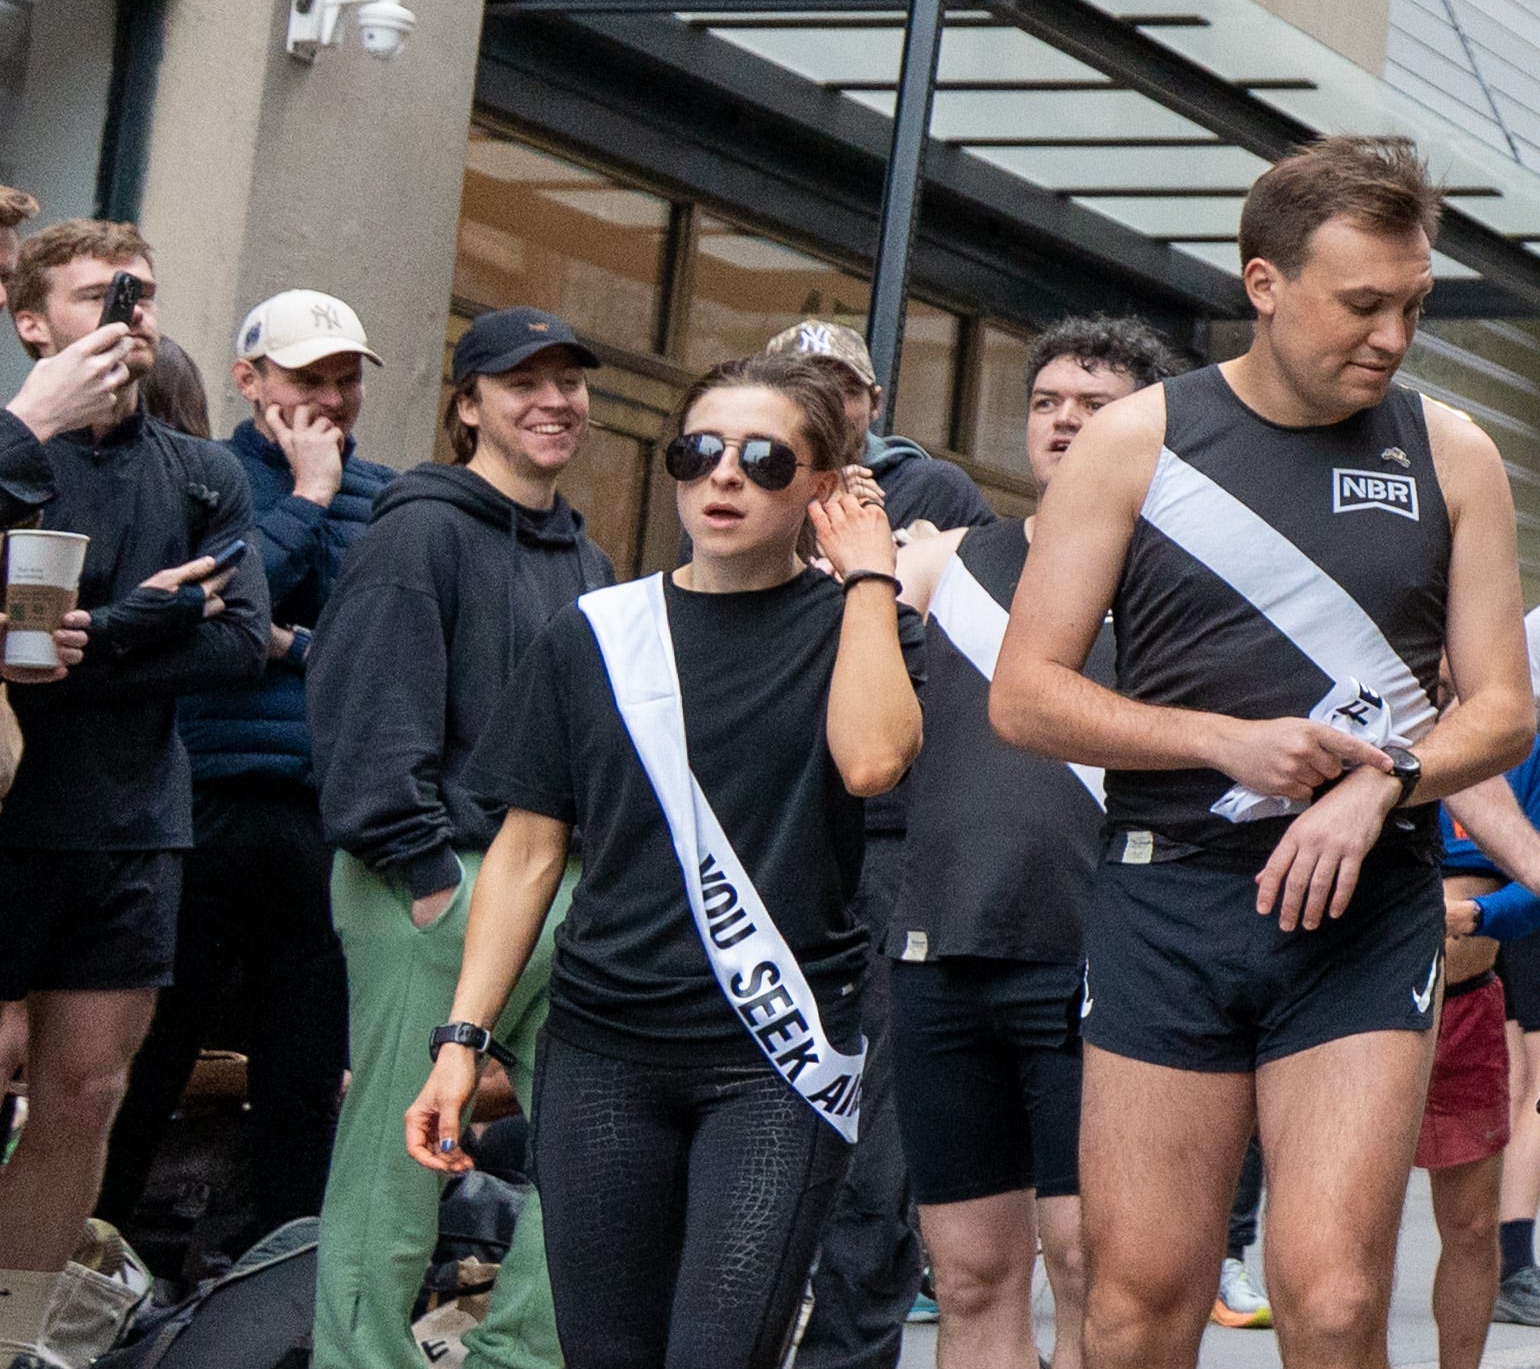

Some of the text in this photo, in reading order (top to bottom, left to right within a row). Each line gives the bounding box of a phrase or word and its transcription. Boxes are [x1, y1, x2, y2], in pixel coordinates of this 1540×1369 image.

[1343, 476, 1409, 503] NBR
[700, 853, 757, 950] YOU
[730, 960, 820, 1084] SEEK
